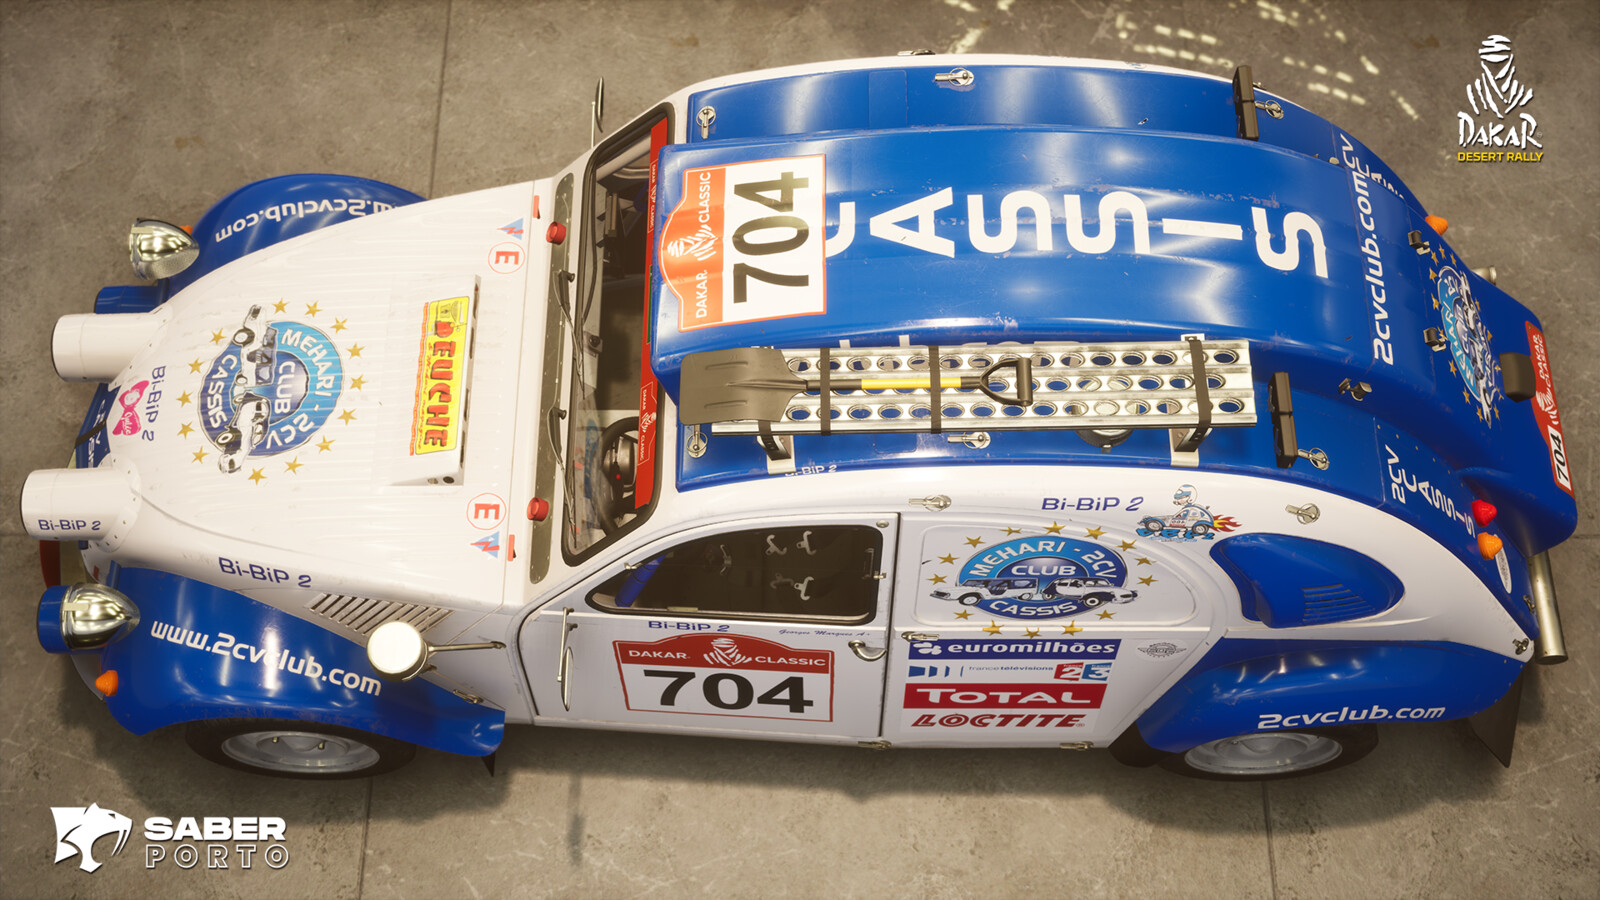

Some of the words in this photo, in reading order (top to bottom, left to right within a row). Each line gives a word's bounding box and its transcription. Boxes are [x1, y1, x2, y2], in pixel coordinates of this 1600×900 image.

[698, 171, 711, 223] CLASSIC
[732, 171, 810, 304] 704
[1351, 170, 1394, 366] 2cvclub.com
[695, 269, 708, 319] DAKAR
[280, 328, 336, 397] MEHARI
[1533, 334, 1548, 380] DAKAR
[147, 365, 167, 424] Bi-BiP
[206, 354, 239, 429] CASSIS
[274, 361, 296, 414] CLUB
[424, 320, 457, 447] DEUCHE
[141, 429, 155, 442] 2
[266, 412, 315, 450] 2CV
[1384, 443, 1406, 504] 2CV
[1551, 433, 1569, 482] 704
[1041, 497, 1121, 511] Bi-BiP
[1125, 496, 1145, 511] 2
[1402, 468, 1476, 539] CASSIS
[38, 519, 87, 532] Bi-BiP
[91, 520, 102, 531] 2
[217, 556, 290, 584] Bi-BiP
[297, 574, 312, 588] 2
[968, 540, 1067, 577] MEHARI
[1081, 550, 1117, 579] 2CV
[1011, 565, 1077, 576] CLUB
[648, 620, 711, 632] Bi-BiP
[716, 624, 730, 632] 2
[988, 600, 1079, 617] CASSIS
[150, 620, 382, 697] www.2cvclub.com
[628, 650, 687, 660] DAKAR
[755, 656, 826, 666] CLASSIC
[947, 641, 1116, 654] euromilhões
[643, 669, 814, 714] 704
[1060, 667, 1082, 678] 2
[1088, 667, 1111, 679] 3
[916, 688, 1092, 704] TOTAL
[911, 713, 1087, 728] LOCTITE
[1257, 705, 1447, 729] 2cvclub.com
